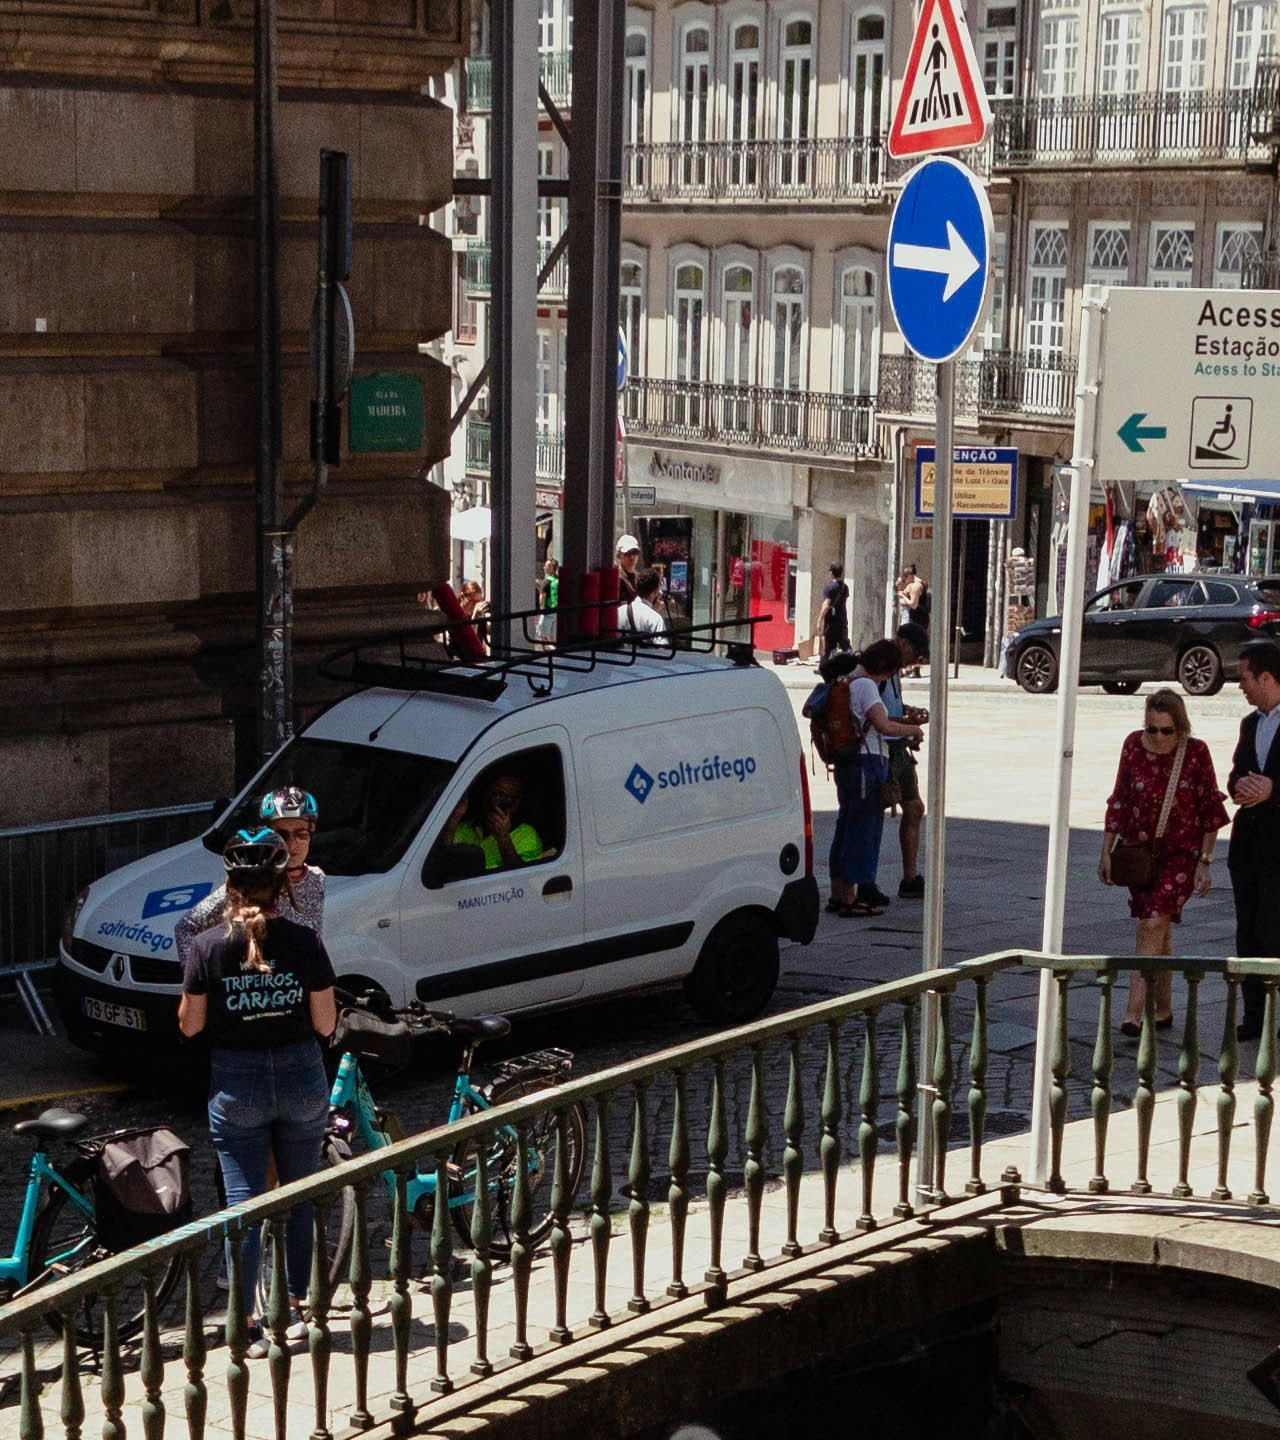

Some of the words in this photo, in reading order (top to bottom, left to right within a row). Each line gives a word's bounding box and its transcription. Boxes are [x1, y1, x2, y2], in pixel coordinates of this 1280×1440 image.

[1195, 334, 1280, 361] Estação
[1194, 362, 1238, 376] Acess
[1244, 363, 1257, 376] to
[368, 406, 407, 417] MADEIRA
[953, 449, 997, 462] ENÇÃO
[661, 460, 721, 484] Santander
[658, 754, 756, 789] soltráfego
[457, 886, 525, 910] MANUTENÇÃO
[97, 919, 174, 952] soltráfego
[226, 987, 303, 1010] CARAGO!
